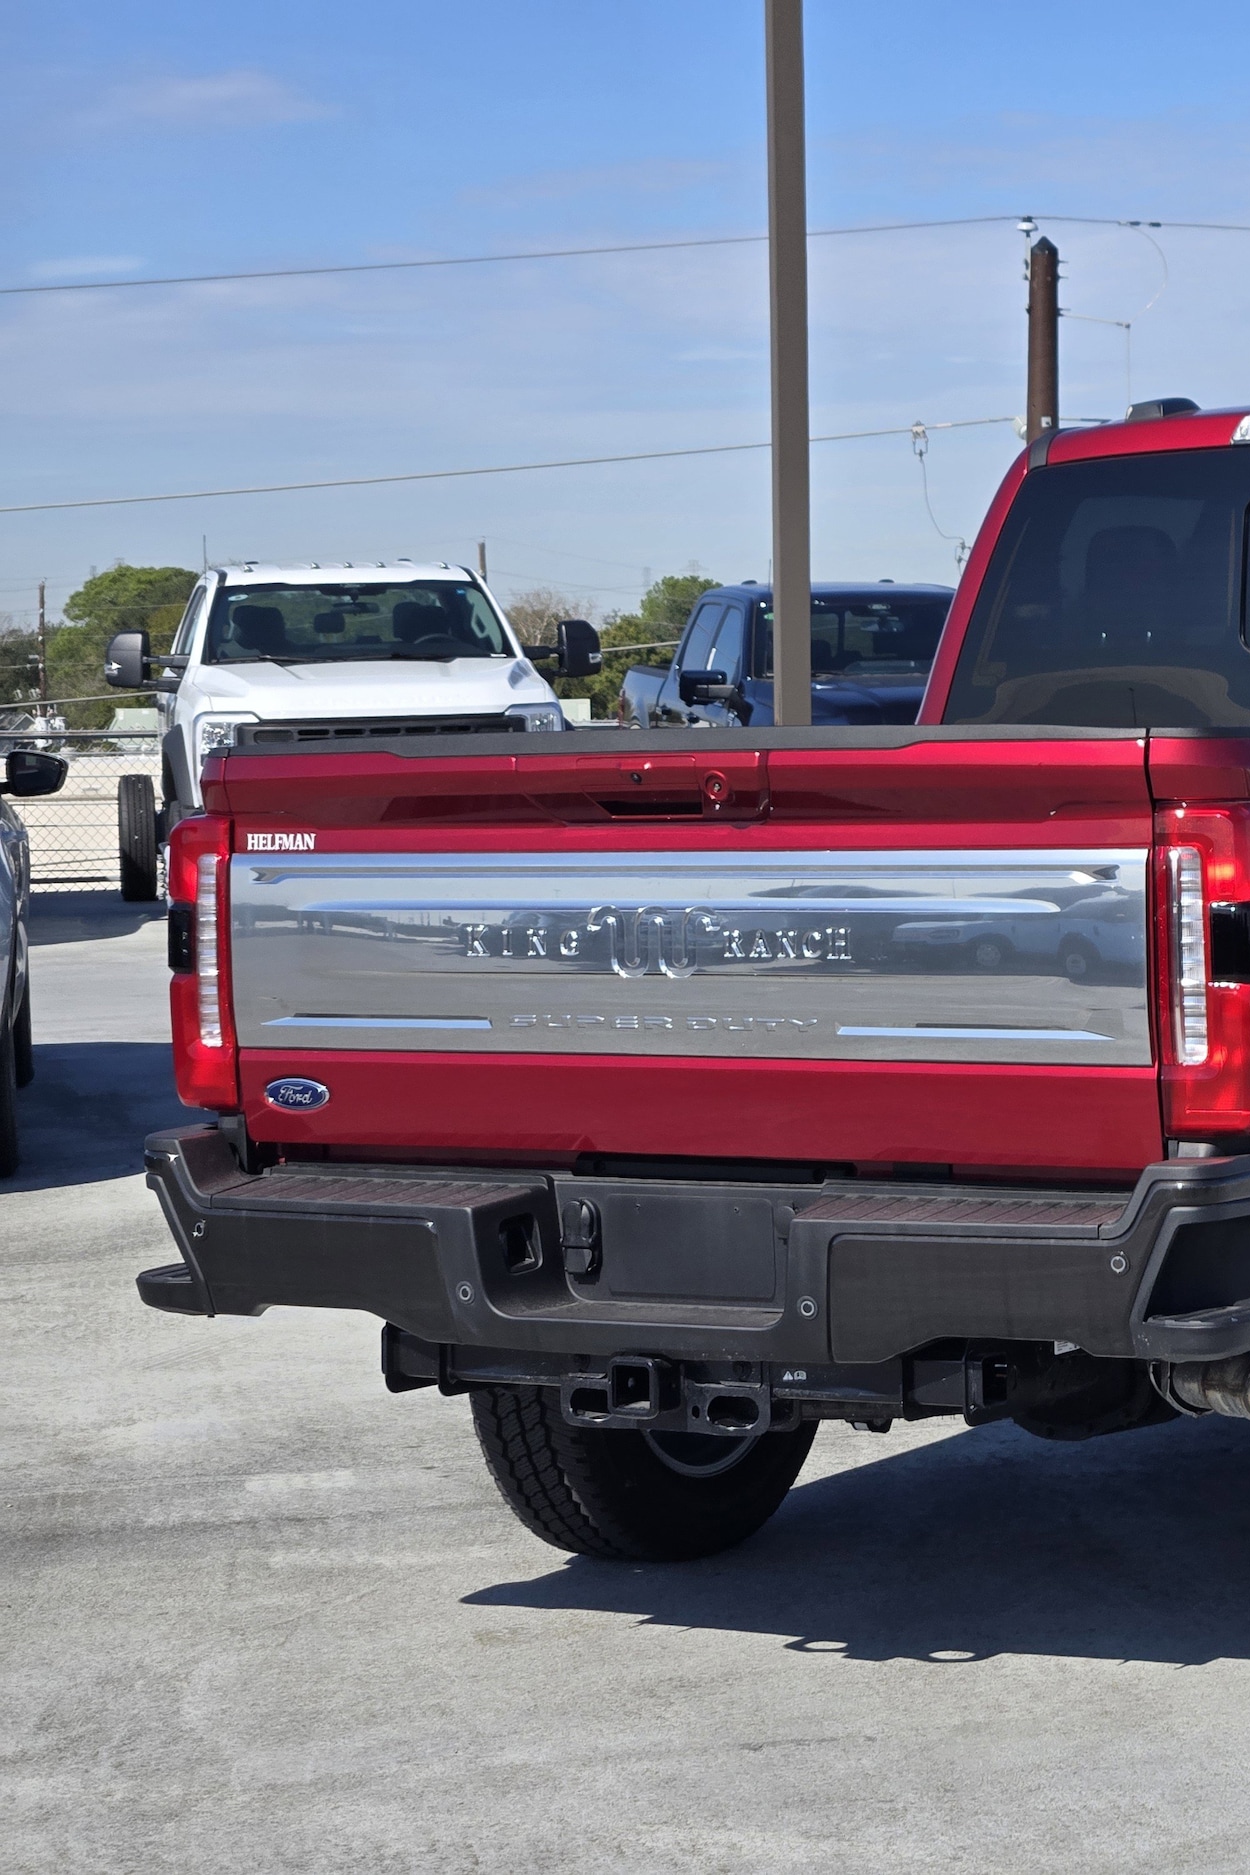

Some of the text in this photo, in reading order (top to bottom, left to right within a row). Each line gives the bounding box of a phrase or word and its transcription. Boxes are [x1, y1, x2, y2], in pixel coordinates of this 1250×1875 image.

[247, 833, 316, 850] HELFMAN
[466, 924, 853, 960] KING RANCH
[509, 1014, 819, 1032] SUPER DUTY
[278, 1085, 313, 1104] Ford
